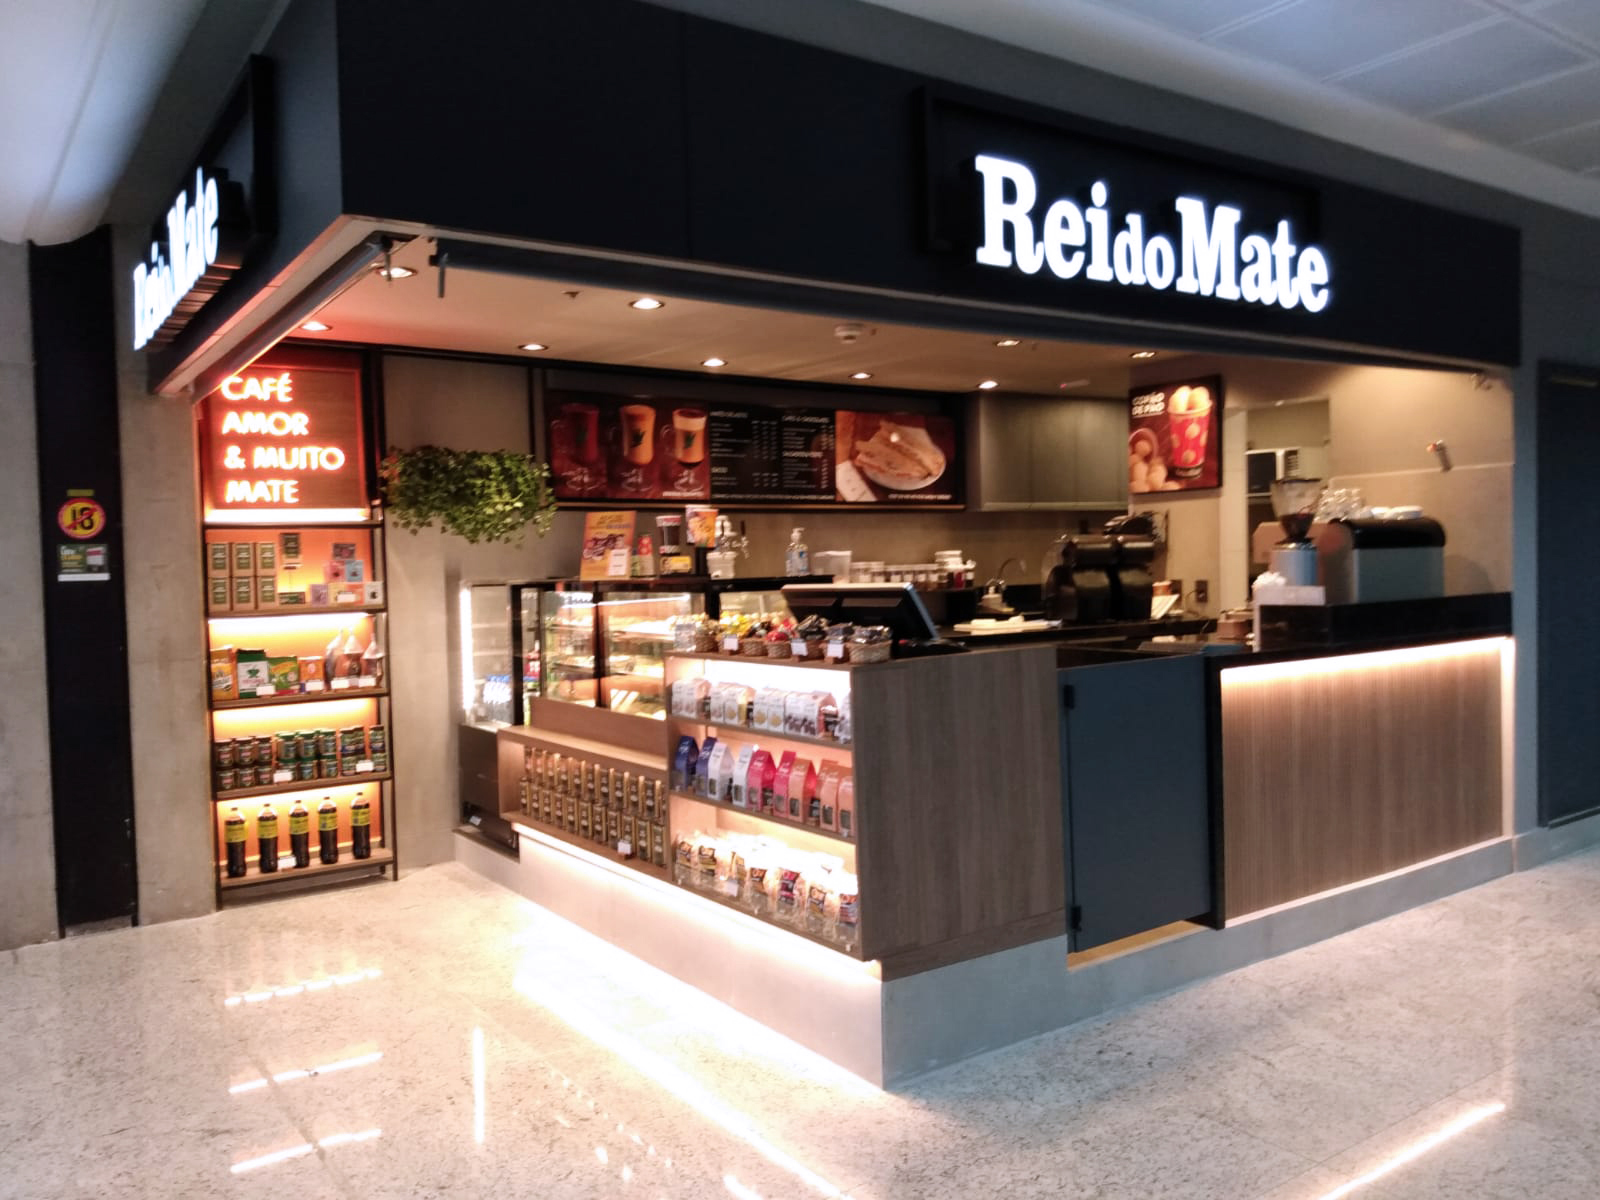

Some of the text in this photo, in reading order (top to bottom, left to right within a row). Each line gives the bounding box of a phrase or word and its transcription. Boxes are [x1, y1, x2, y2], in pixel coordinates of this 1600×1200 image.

[975, 154, 1114, 282] Rei
[1175, 195, 1330, 313] Mate
[220, 371, 294, 403] CAFÉ
[221, 410, 310, 437] AMOR
[223, 444, 346, 471] & MUITO
[224, 478, 300, 504] MATE
